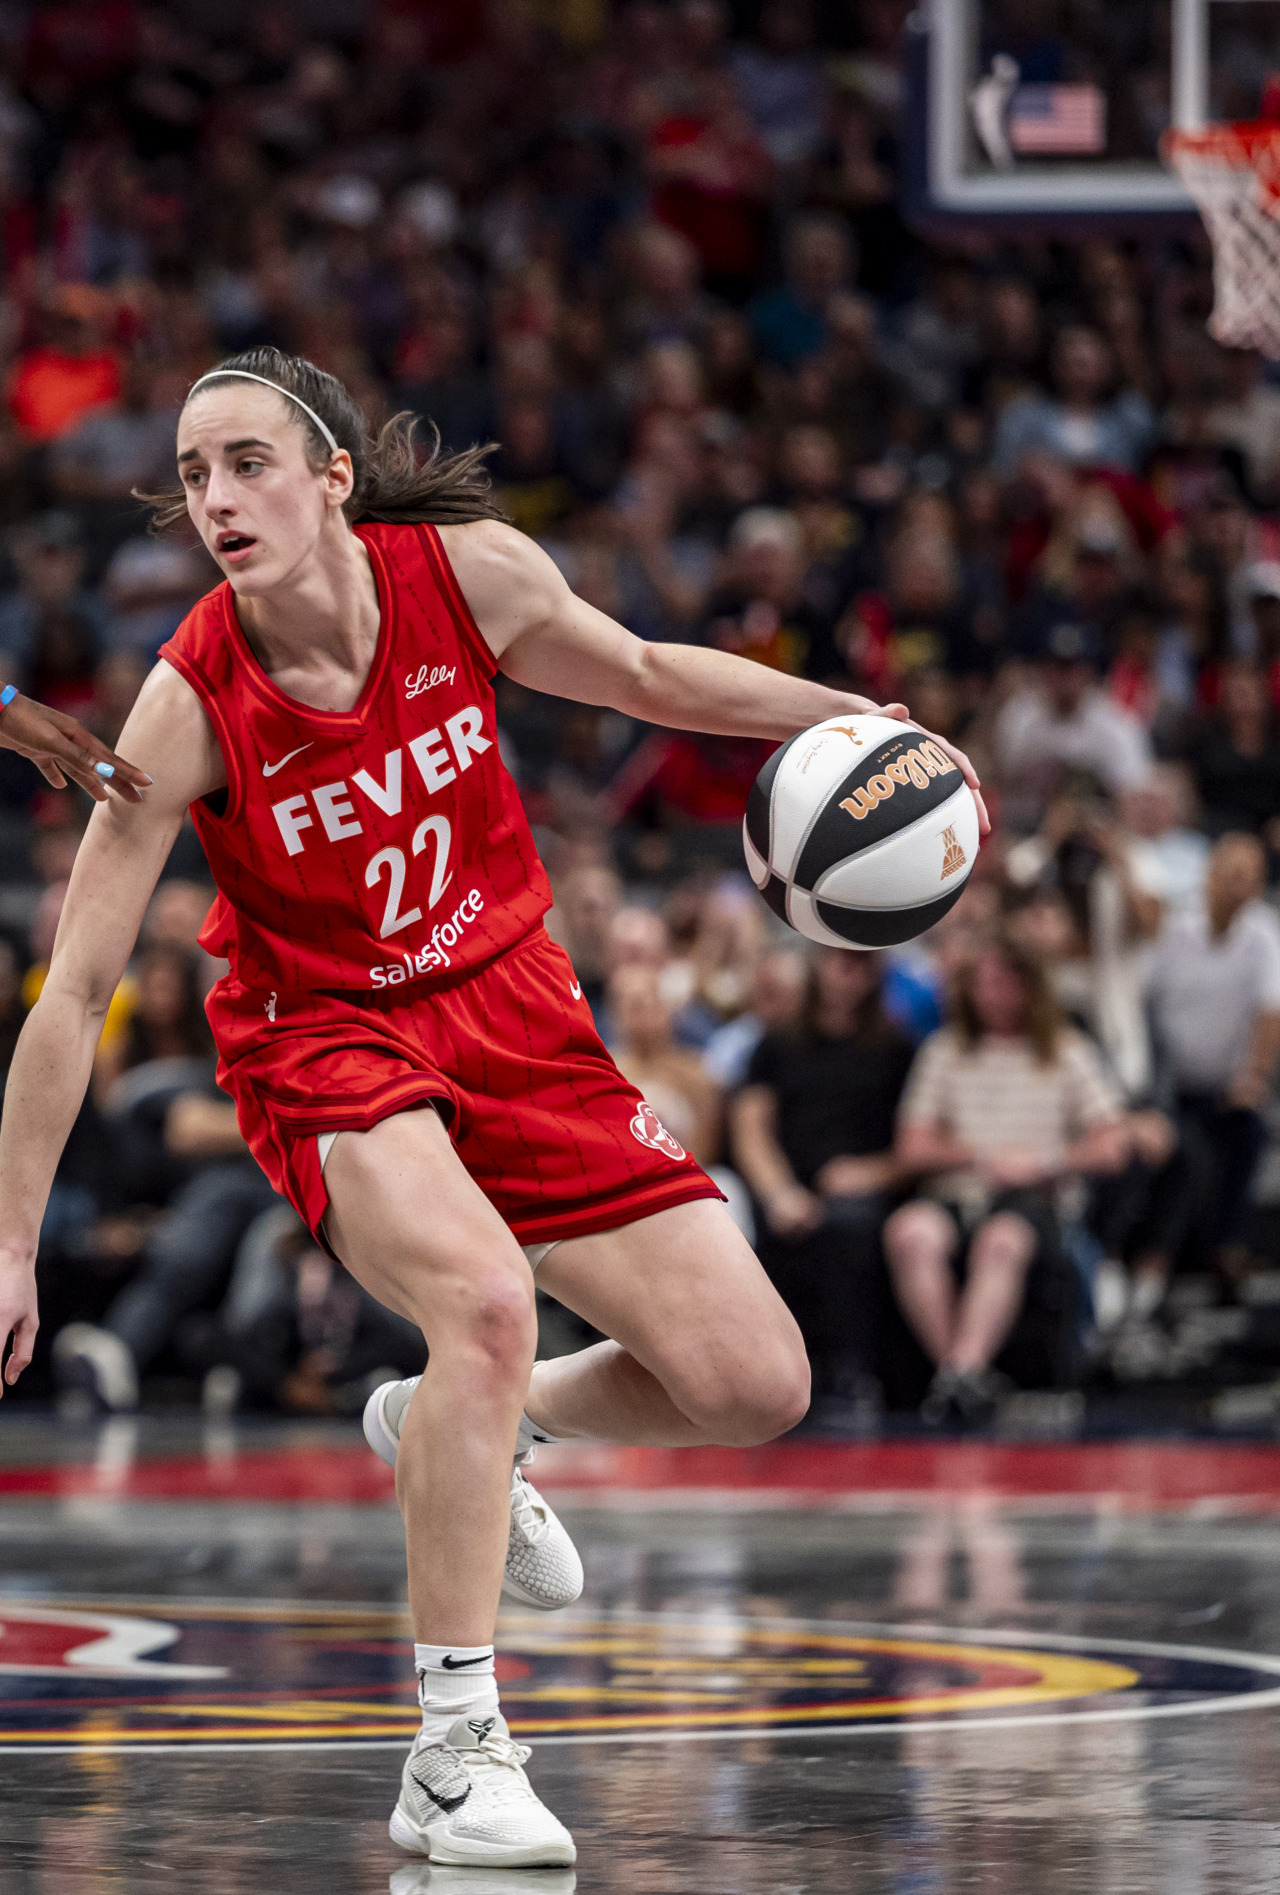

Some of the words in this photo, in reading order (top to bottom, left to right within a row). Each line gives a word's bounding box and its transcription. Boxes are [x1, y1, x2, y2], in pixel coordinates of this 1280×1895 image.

[405, 664, 456, 699] Lilly
[270, 704, 494, 857] FEVER
[838, 739, 958, 820] Wilson
[364, 813, 453, 939] 22
[369, 888, 484, 989] salesforce
